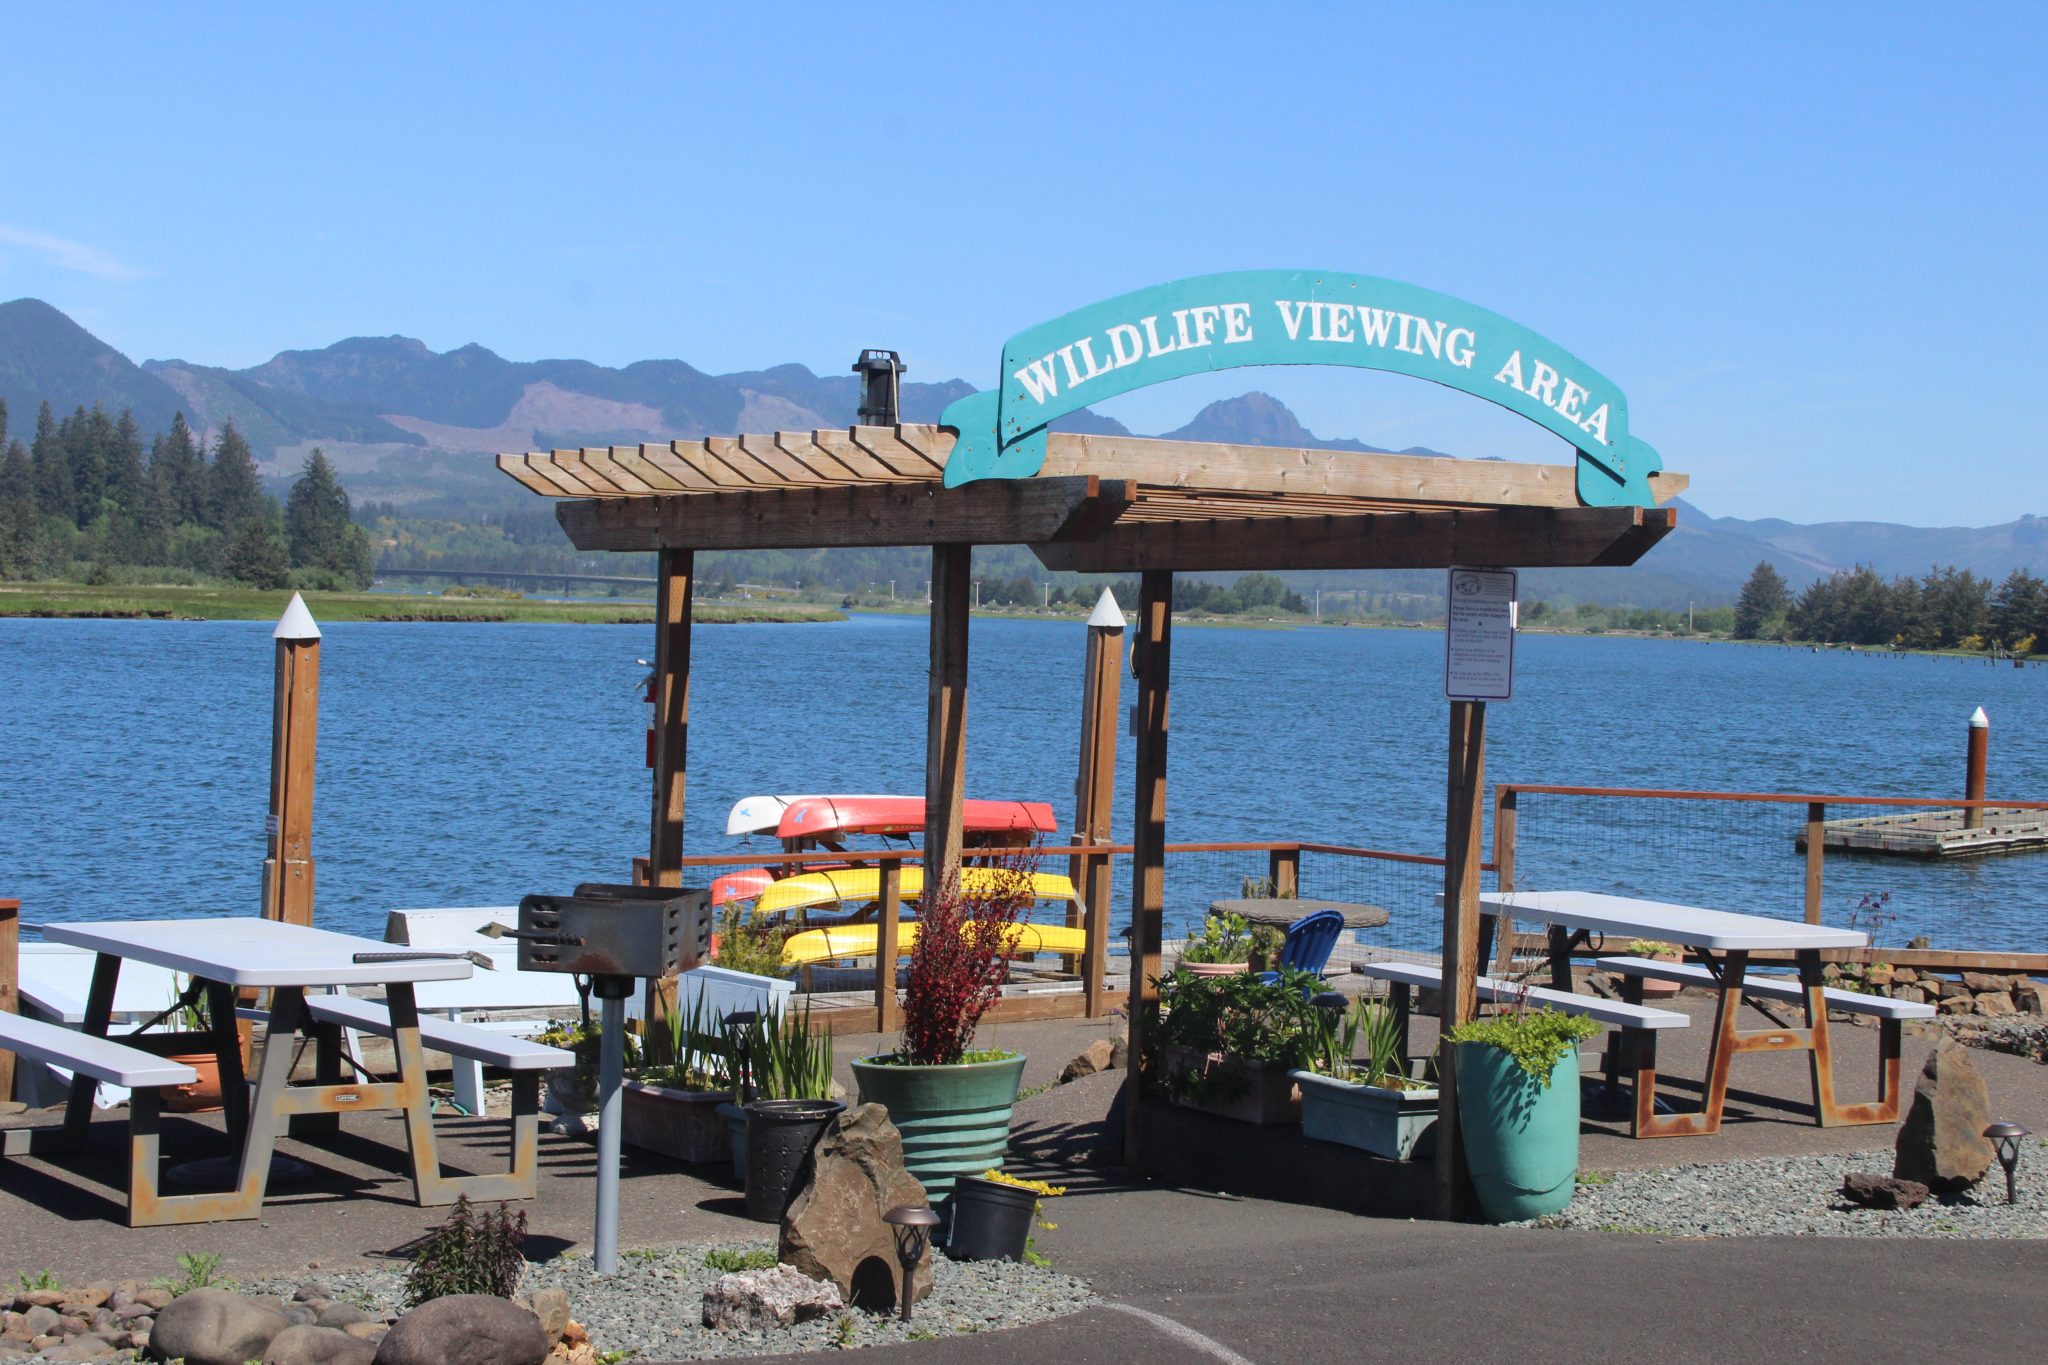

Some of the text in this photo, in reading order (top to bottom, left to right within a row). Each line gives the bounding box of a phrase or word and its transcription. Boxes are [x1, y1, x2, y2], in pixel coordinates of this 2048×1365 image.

[1014, 300, 1609, 446] WILDLIFE VIEWING AREA
